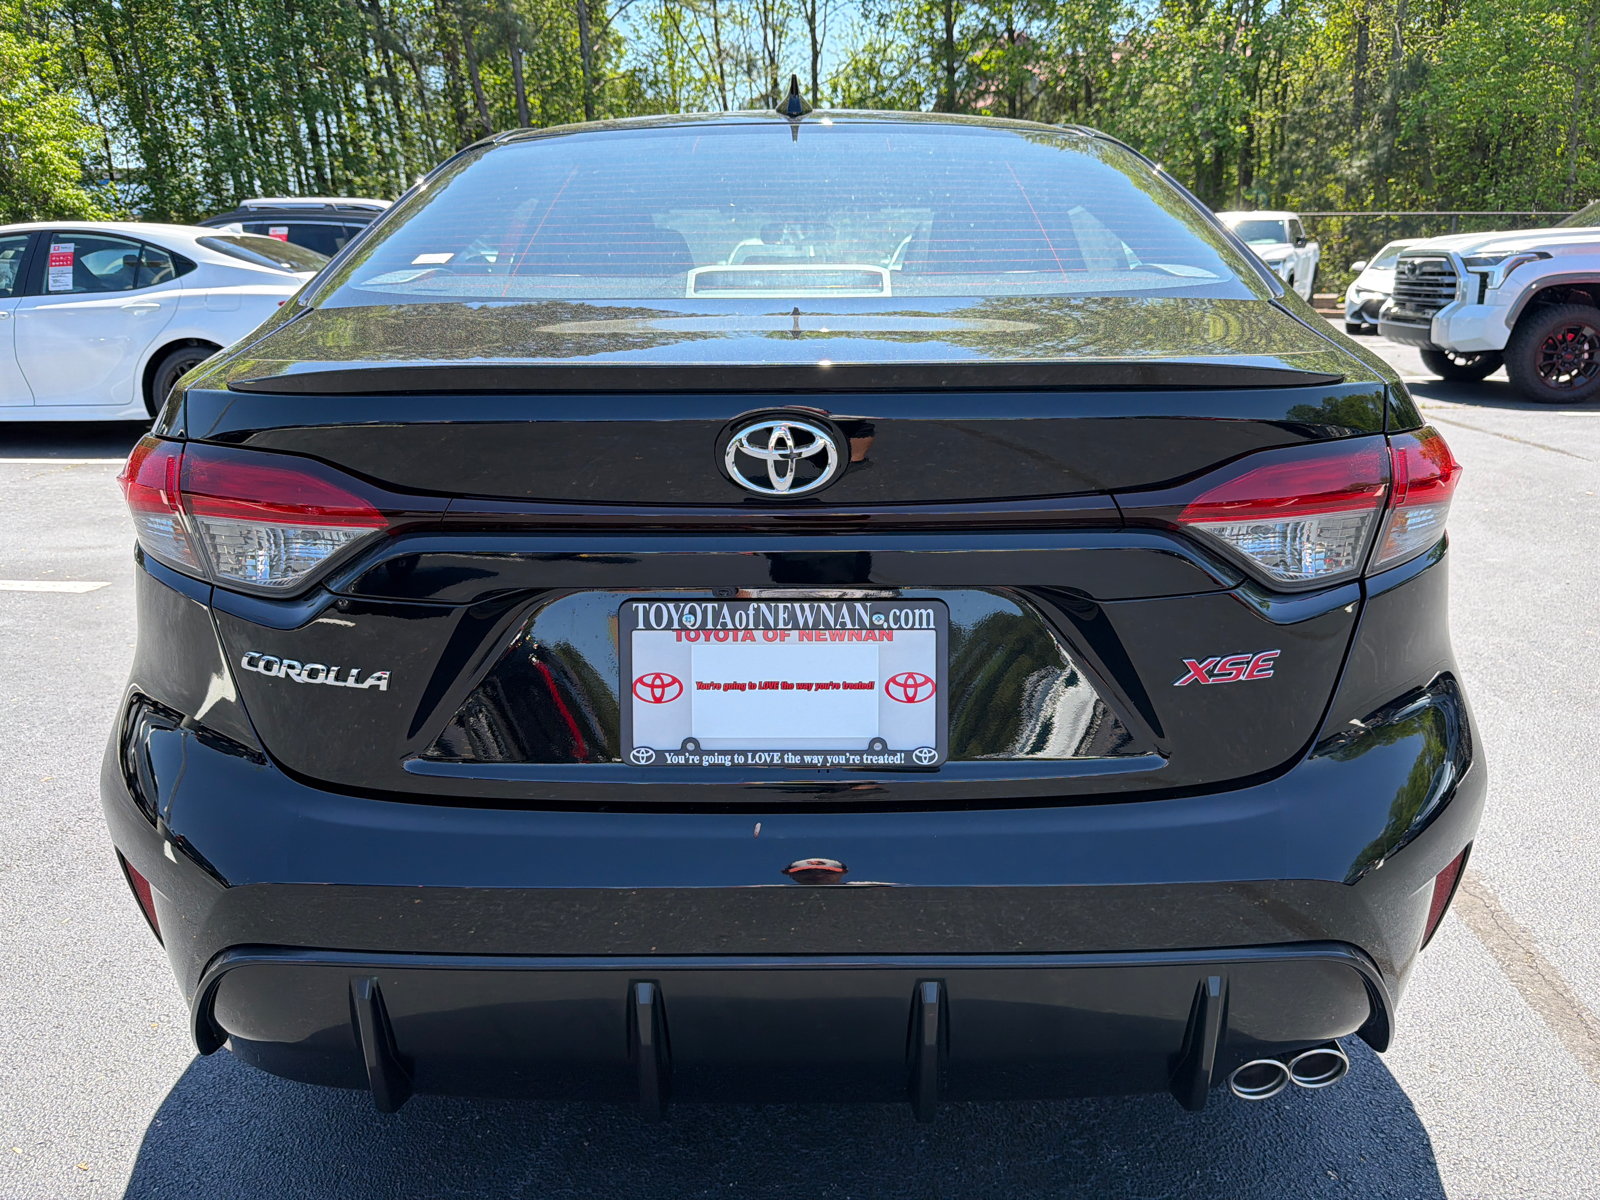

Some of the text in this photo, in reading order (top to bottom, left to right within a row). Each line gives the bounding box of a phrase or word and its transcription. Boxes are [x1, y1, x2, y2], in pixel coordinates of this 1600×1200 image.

[673, 630, 893, 642] TOYOTA OF NEWNAN
[241, 651, 391, 691] COROLLA
[1173, 649, 1281, 686] XSE
[695, 681, 875, 692] You're going to LOVE the way you're treated!
[664, 752, 905, 766] You're going to LOVE the way you're treated!
